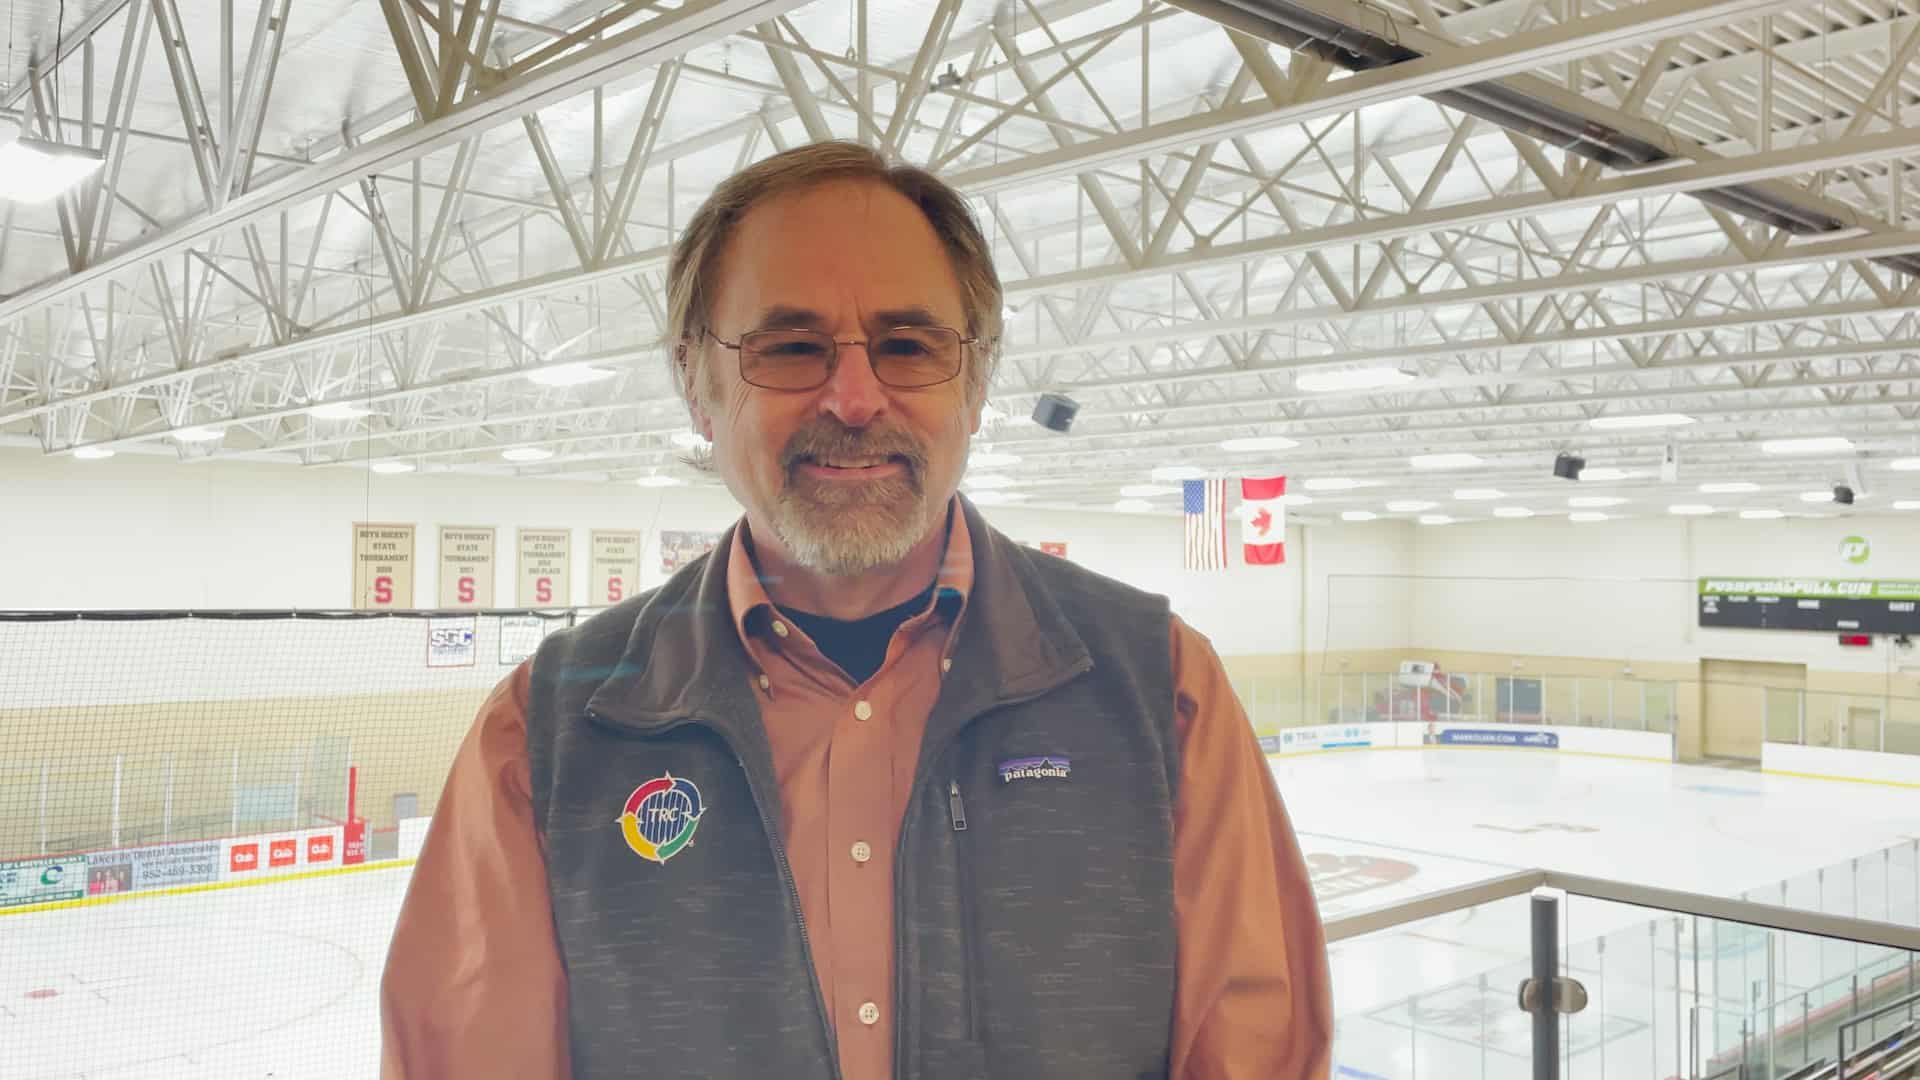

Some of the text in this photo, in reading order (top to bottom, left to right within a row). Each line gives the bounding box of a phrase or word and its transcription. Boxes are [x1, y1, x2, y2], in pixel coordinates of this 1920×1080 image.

[375, 576, 393, 604] S
[458, 576, 475, 604] S
[536, 577, 552, 603] S
[608, 577, 622, 603] S
[1004, 767, 1067, 783] patagonia
[648, 807, 678, 823] TRC
